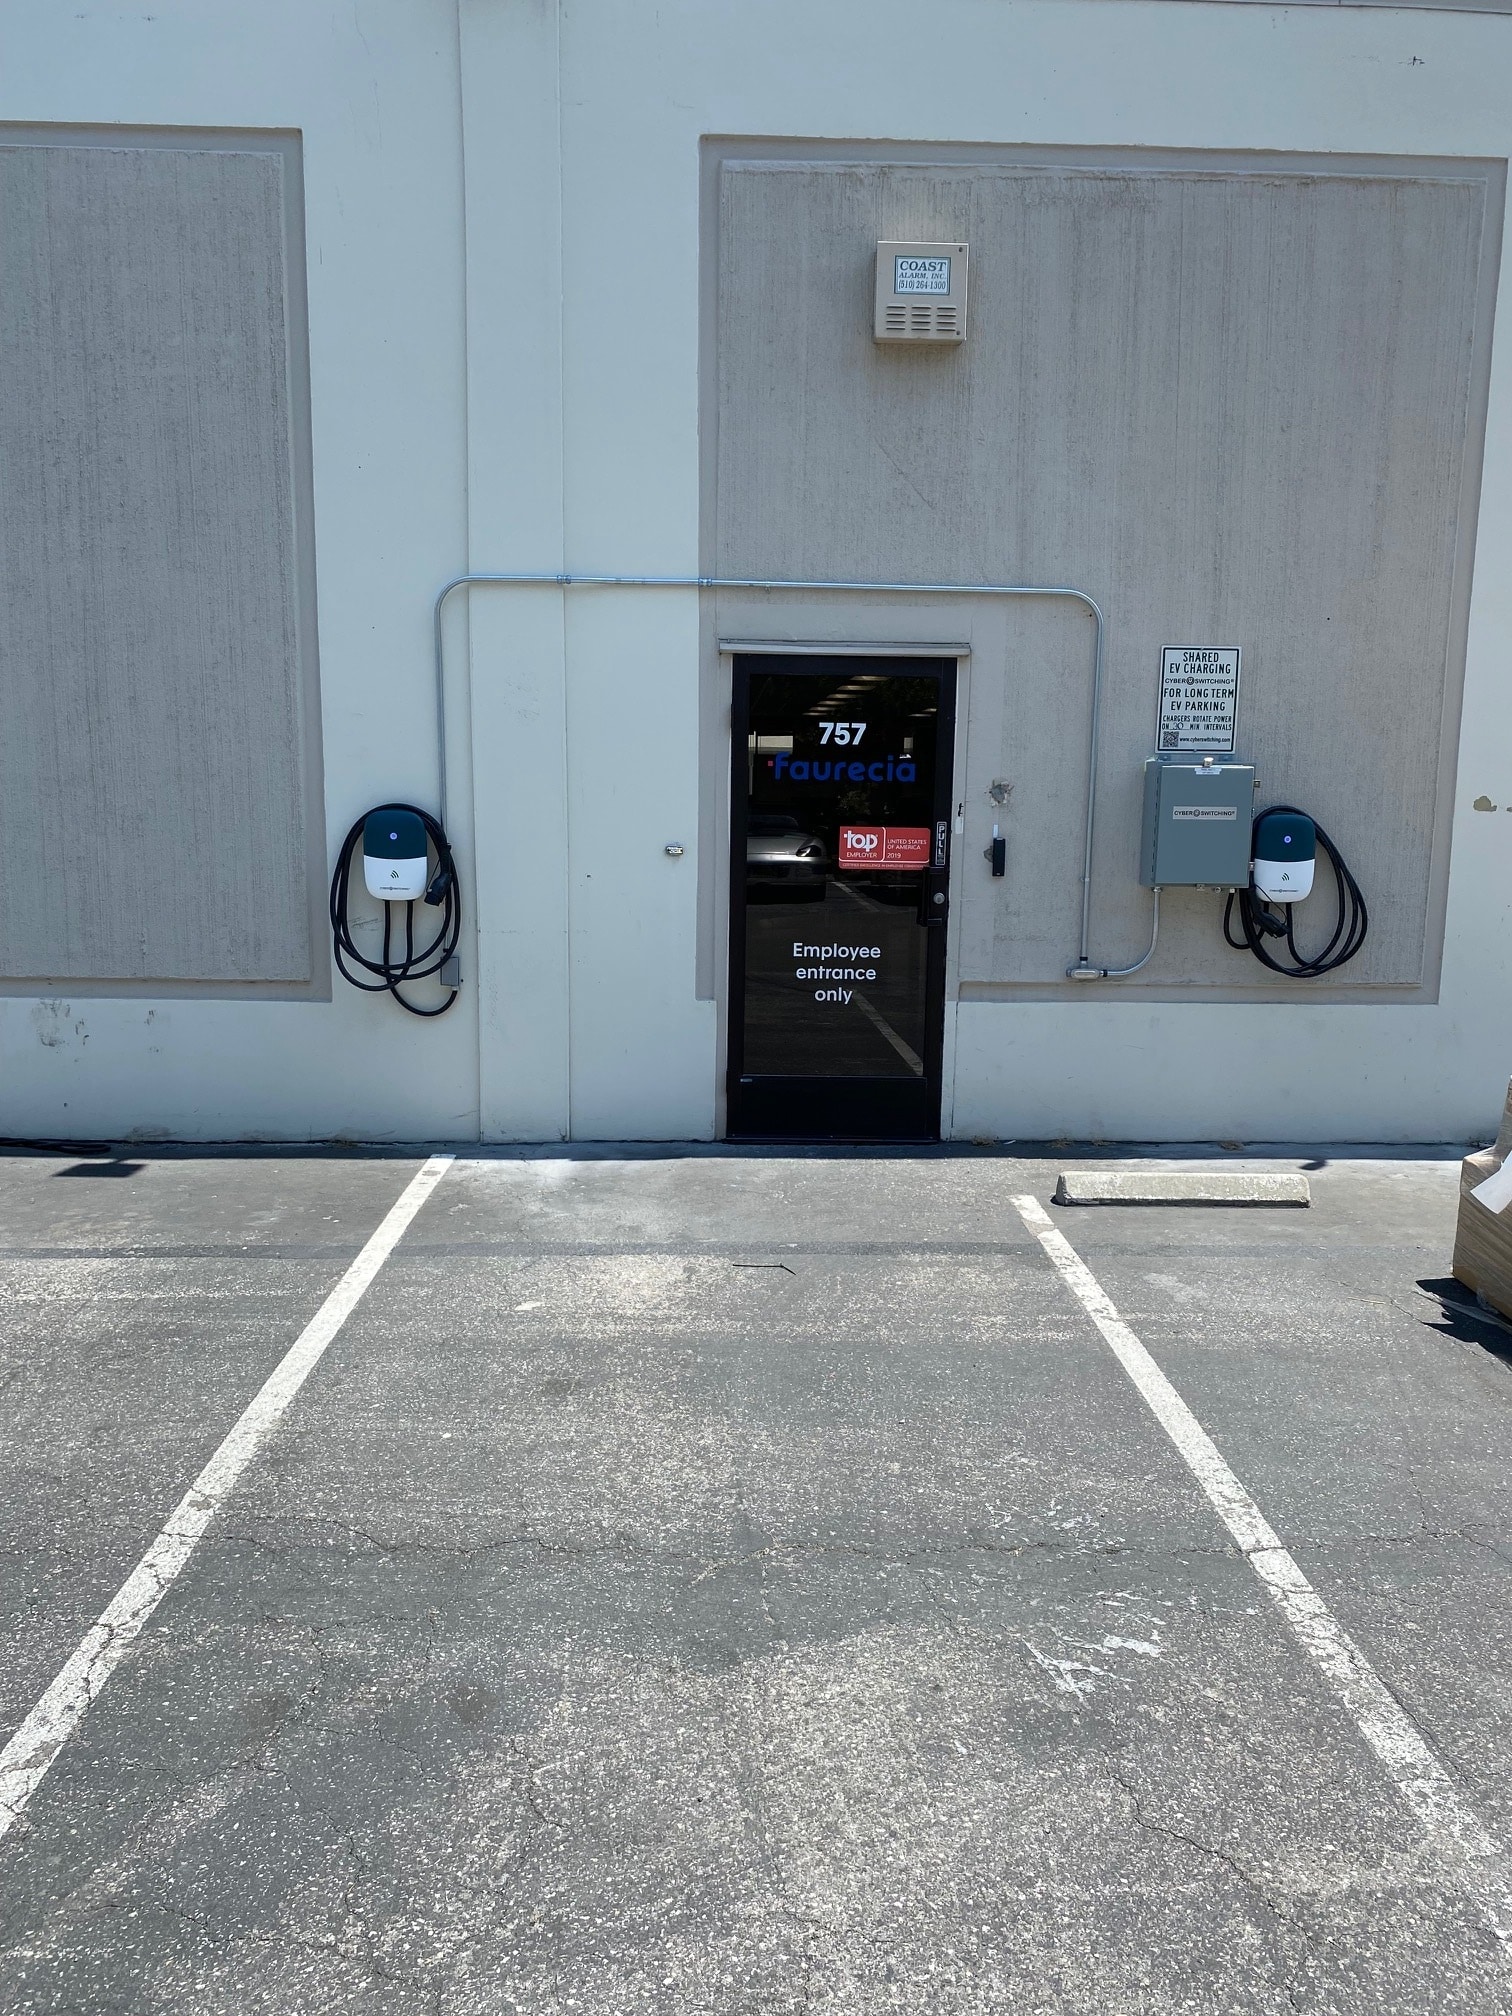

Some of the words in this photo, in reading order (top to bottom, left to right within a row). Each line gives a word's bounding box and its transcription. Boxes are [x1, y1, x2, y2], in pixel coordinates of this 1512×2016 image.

[900, 261, 946, 271] COAST
[899, 280, 914, 290] (510)
[1183, 652, 1219, 662] SHARED
[1170, 663, 1180, 673] EV
[1184, 663, 1231, 674] CHARGING
[1163, 687, 1182, 698] FOR
[1184, 687, 1209, 699] LONG
[1211, 688, 1234, 699] TERM
[1170, 700, 1182, 711] EV
[1184, 701, 1226, 712] PARKING
[1162, 714, 1191, 723] CHARGERS
[1192, 715, 1212, 723] ROTATE
[1213, 715, 1232, 723] POWER
[1161, 723, 1170, 731] ON
[1203, 723, 1232, 731] INTERVALS
[818, 722, 866, 745] 757
[775, 752, 916, 782] faurecia
[843, 830, 879, 852] top
[846, 851, 878, 859] EMPLOYER
[793, 943, 881, 961] Employee
[796, 966, 876, 980] entrance
[815, 987, 852, 1004] only
